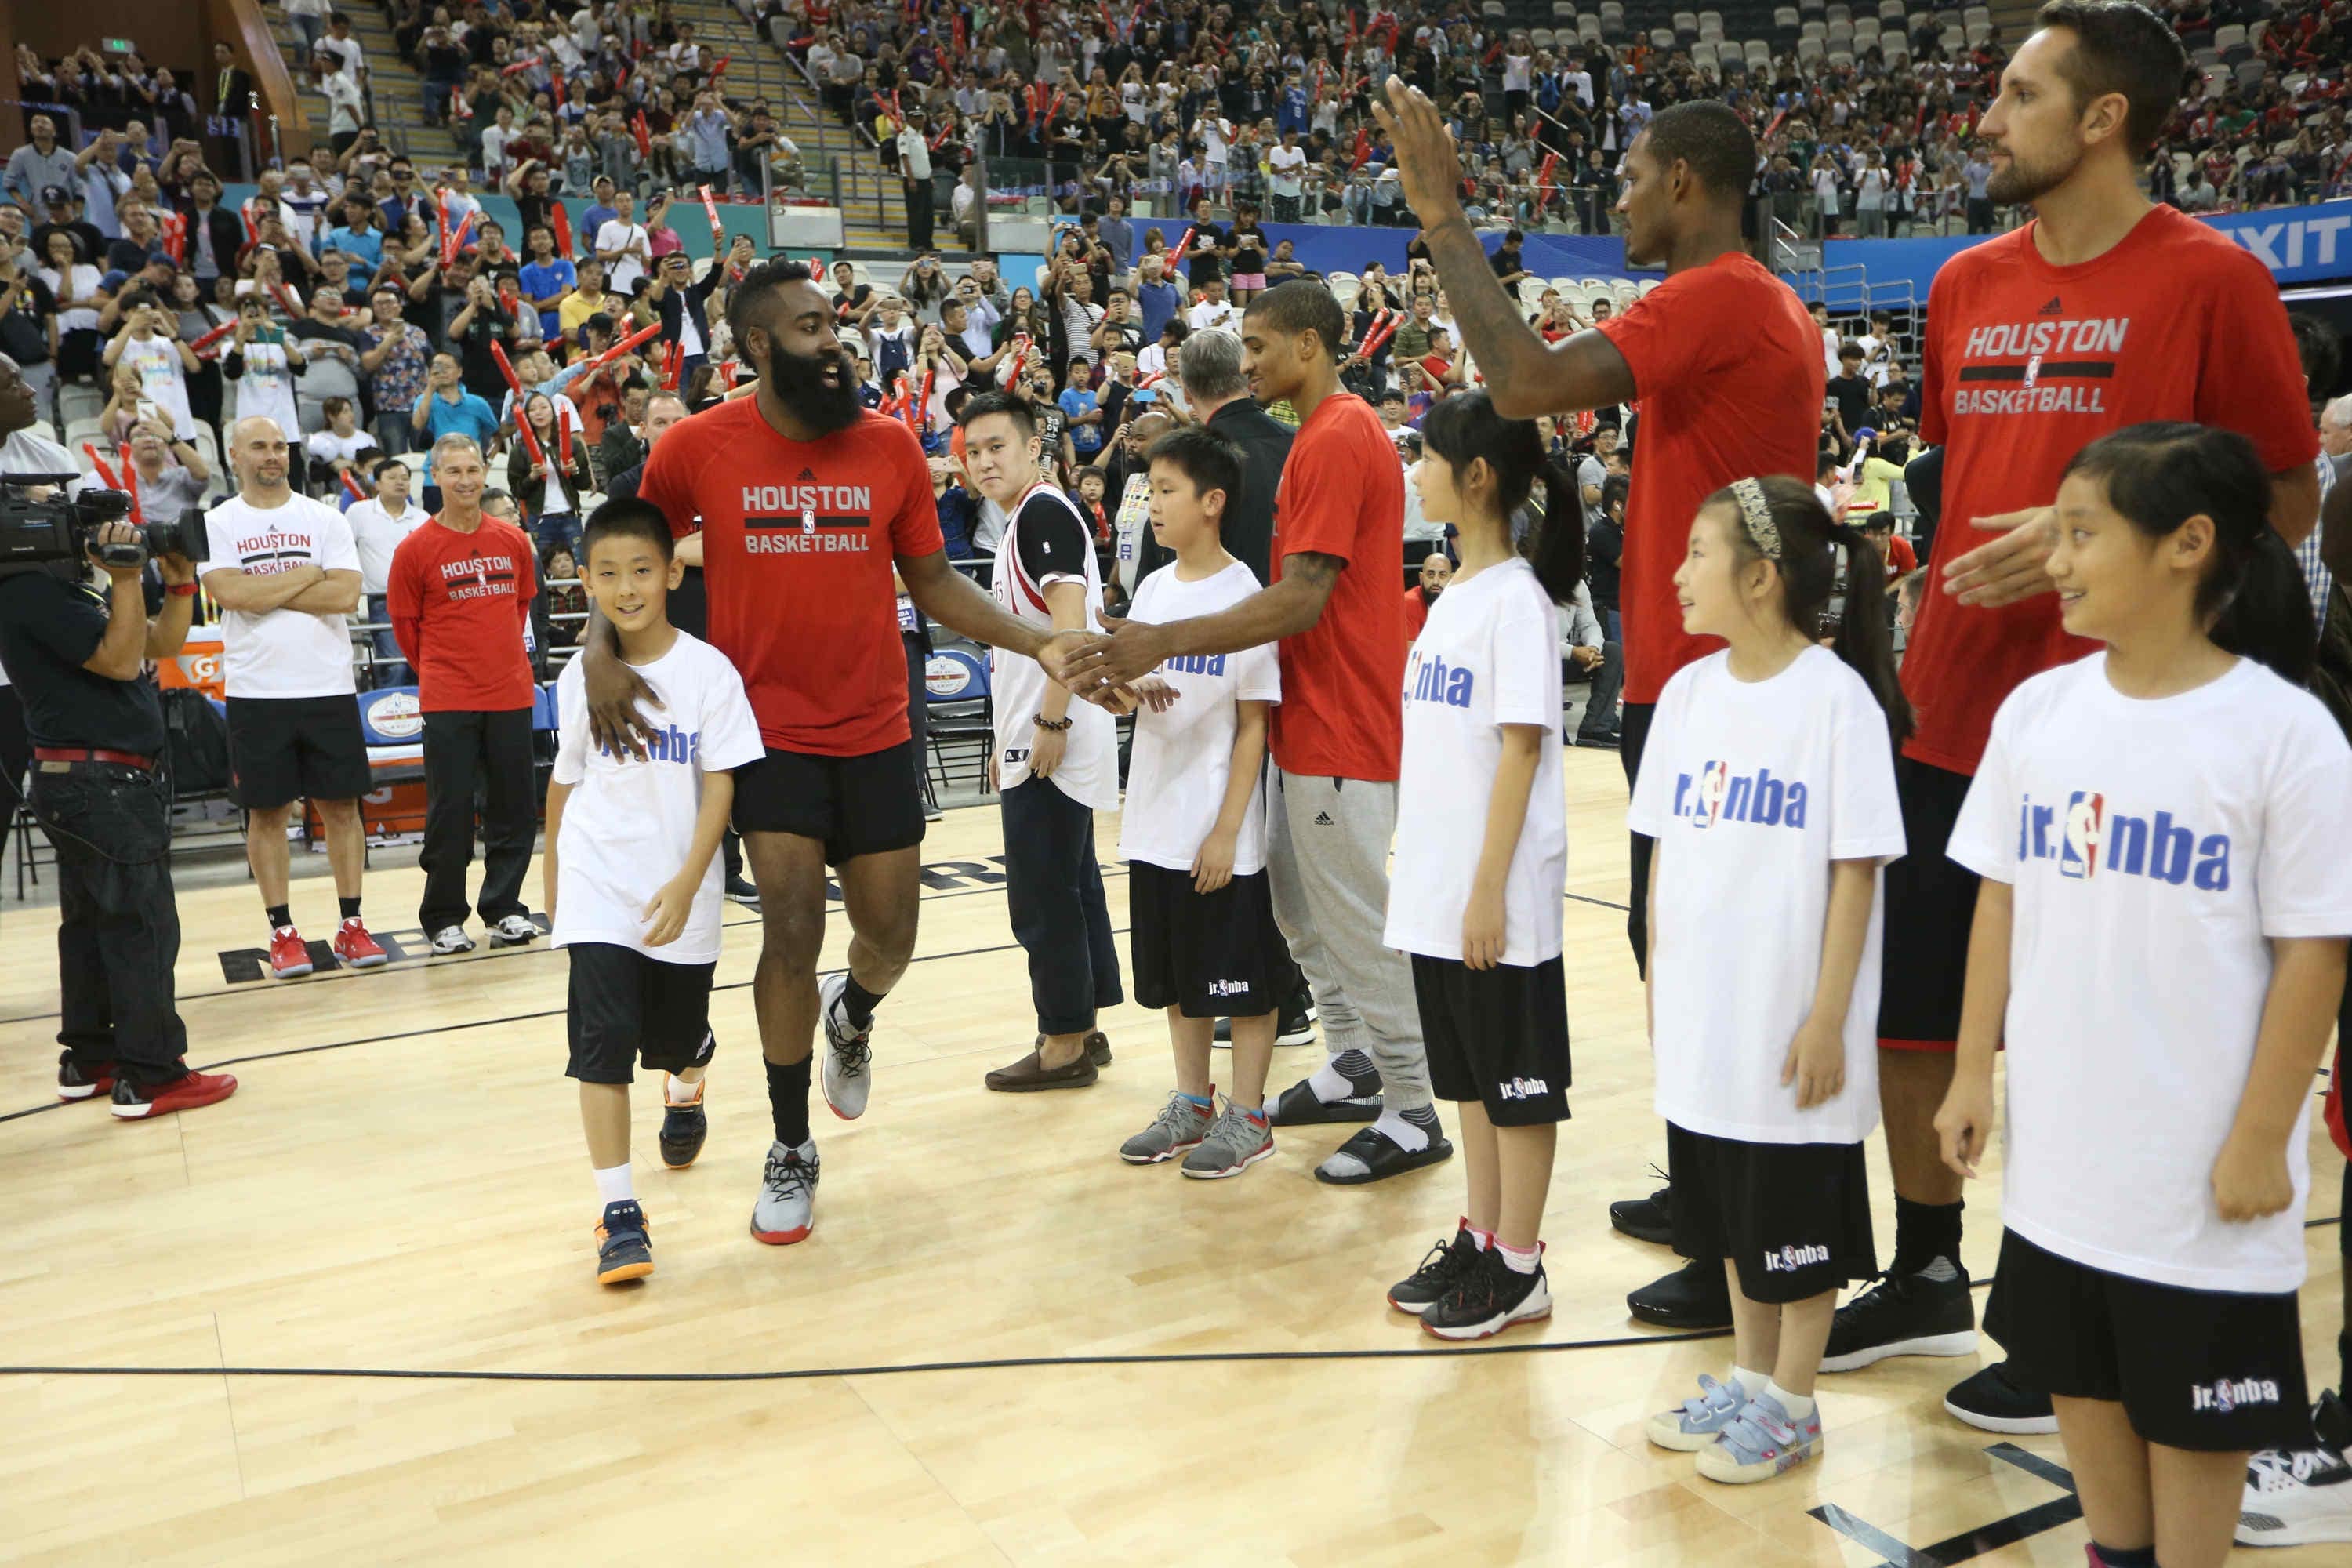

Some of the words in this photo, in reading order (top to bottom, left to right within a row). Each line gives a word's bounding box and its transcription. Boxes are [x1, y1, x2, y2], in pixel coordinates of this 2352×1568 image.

[2220, 216, 2351, 269] XIT
[1964, 318, 2130, 358] HOUSTON
[1955, 387, 2106, 415] BASKETBALL
[742, 485, 871, 510] HOUSTON
[237, 533, 311, 554] HOUSTON
[745, 534, 869, 553] BASKETBALL
[441, 556, 512, 579] HOUSTON
[448, 583, 515, 601] BASKETBALL
[195, 658, 215, 677] G
[1414, 655, 1474, 708] nba
[1723, 768, 1807, 829] nba
[2018, 793, 2057, 862] jr.
[2107, 810, 2230, 891] nba
[1208, 982, 1220, 996] jr.
[1228, 980, 1249, 993] nba
[1499, 1082, 1516, 1099] jr.
[1524, 1077, 1548, 1095] nba
[1764, 1250, 1784, 1271] jr.
[1794, 1244, 1829, 1265] nba
[2191, 1385, 2218, 1410] jr.
[2232, 1377, 2279, 1404] nba
